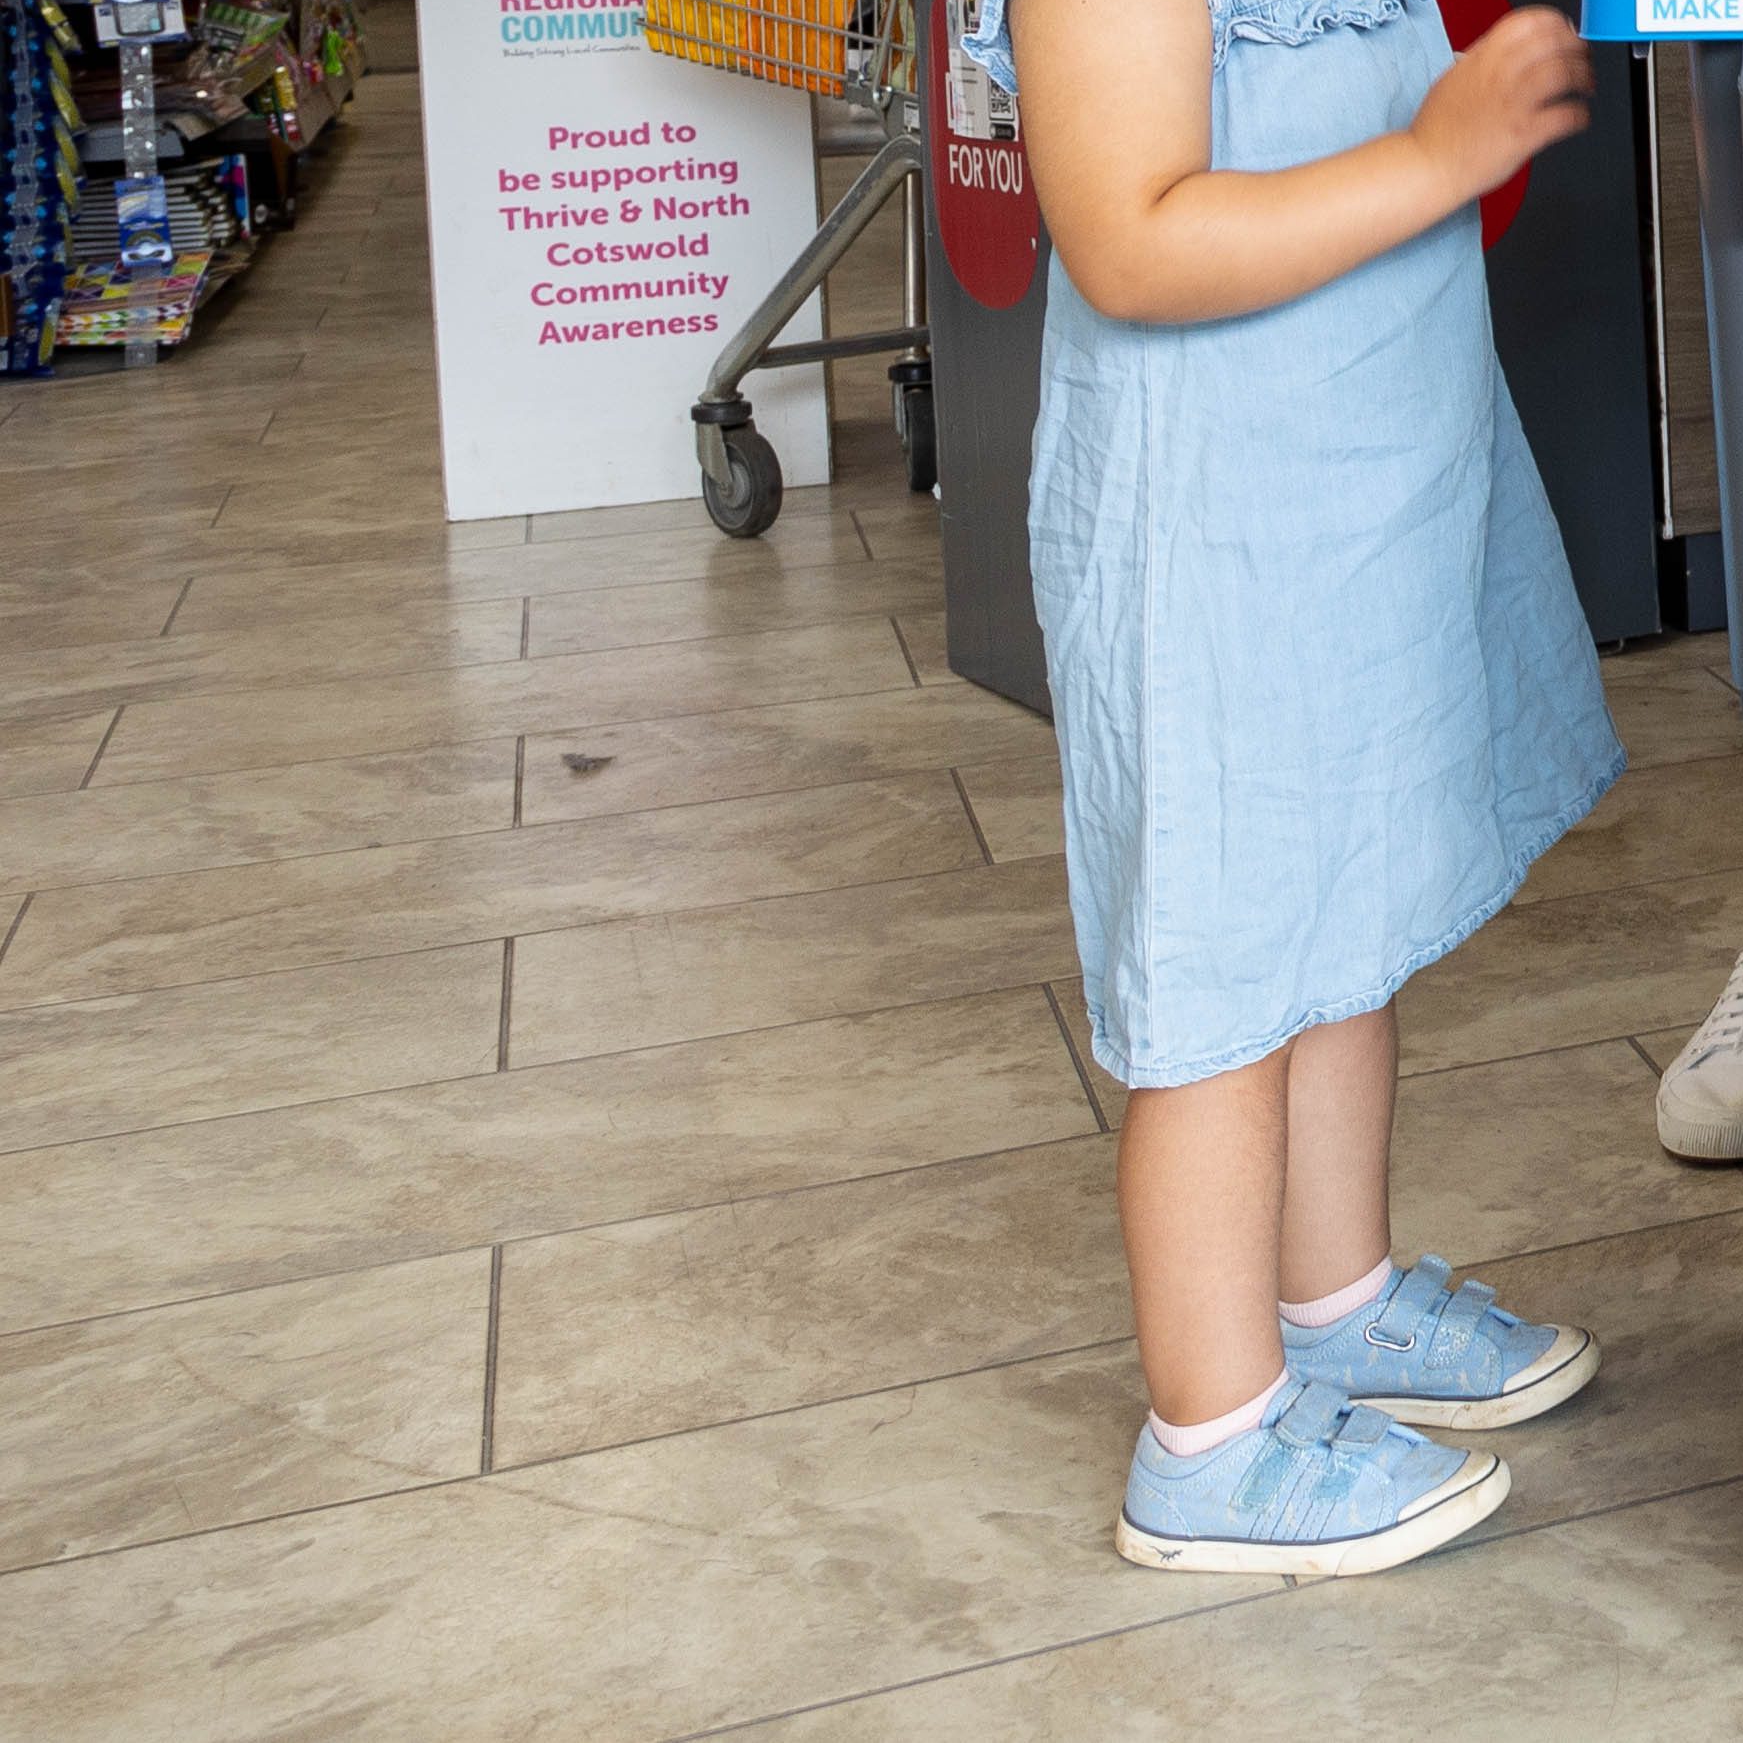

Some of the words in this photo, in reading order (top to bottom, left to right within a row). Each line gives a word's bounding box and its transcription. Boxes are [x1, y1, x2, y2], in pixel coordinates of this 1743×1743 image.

[502, 12, 644, 43] COMMUN
[548, 124, 653, 150] Proud
[661, 122, 697, 143] to
[498, 168, 540, 193] be
[551, 159, 739, 191] supporting
[948, 144, 985, 190] FOR
[985, 148, 1023, 195] YOU
[500, 204, 609, 231] Thrive
[620, 203, 642, 223] &
[653, 194, 750, 221] North
[546, 234, 709, 267] Cotswold
[530, 273, 729, 306] Community
[538, 311, 719, 345] Awareness
